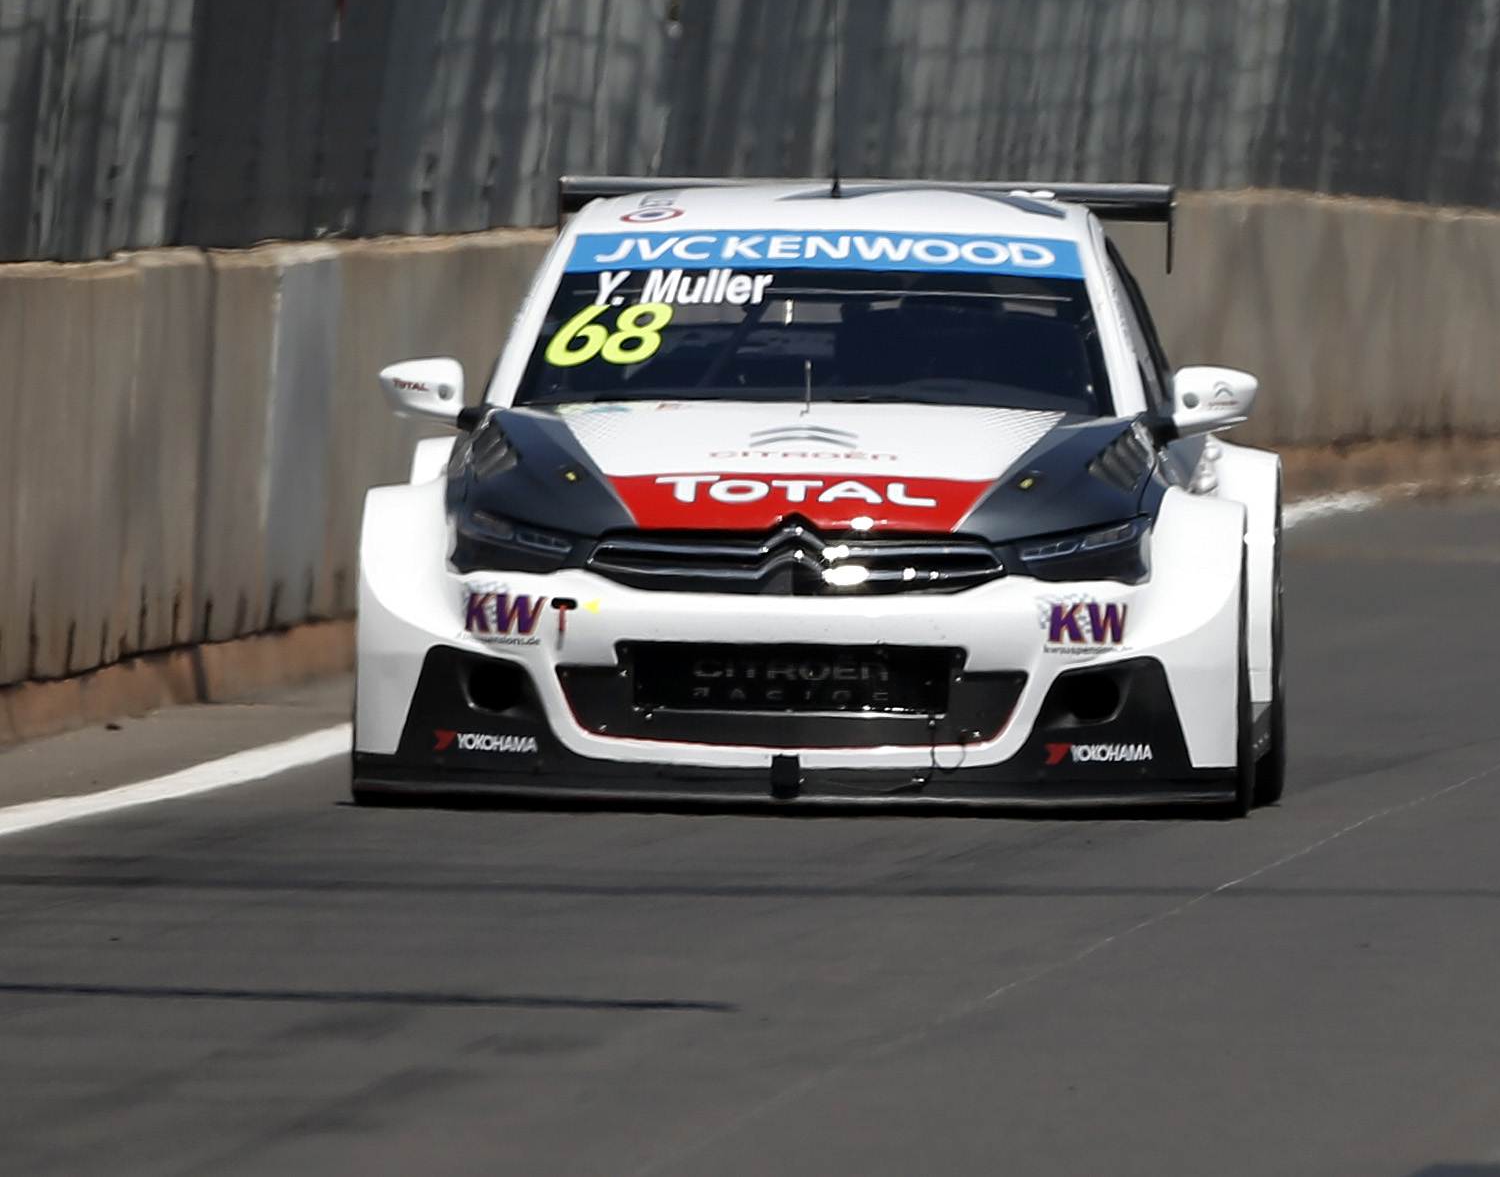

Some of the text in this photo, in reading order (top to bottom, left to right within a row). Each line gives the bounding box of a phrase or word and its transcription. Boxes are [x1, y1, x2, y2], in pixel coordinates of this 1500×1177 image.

[595, 267, 774, 306] Y. Muller
[544, 303, 674, 368] 68
[393, 378, 429, 392] TOTAL
[465, 593, 549, 635] KW
[1048, 602, 1128, 644] KW
[457, 733, 538, 753] YOKOHAMA
[1069, 743, 1153, 762] YOKOHAMA
